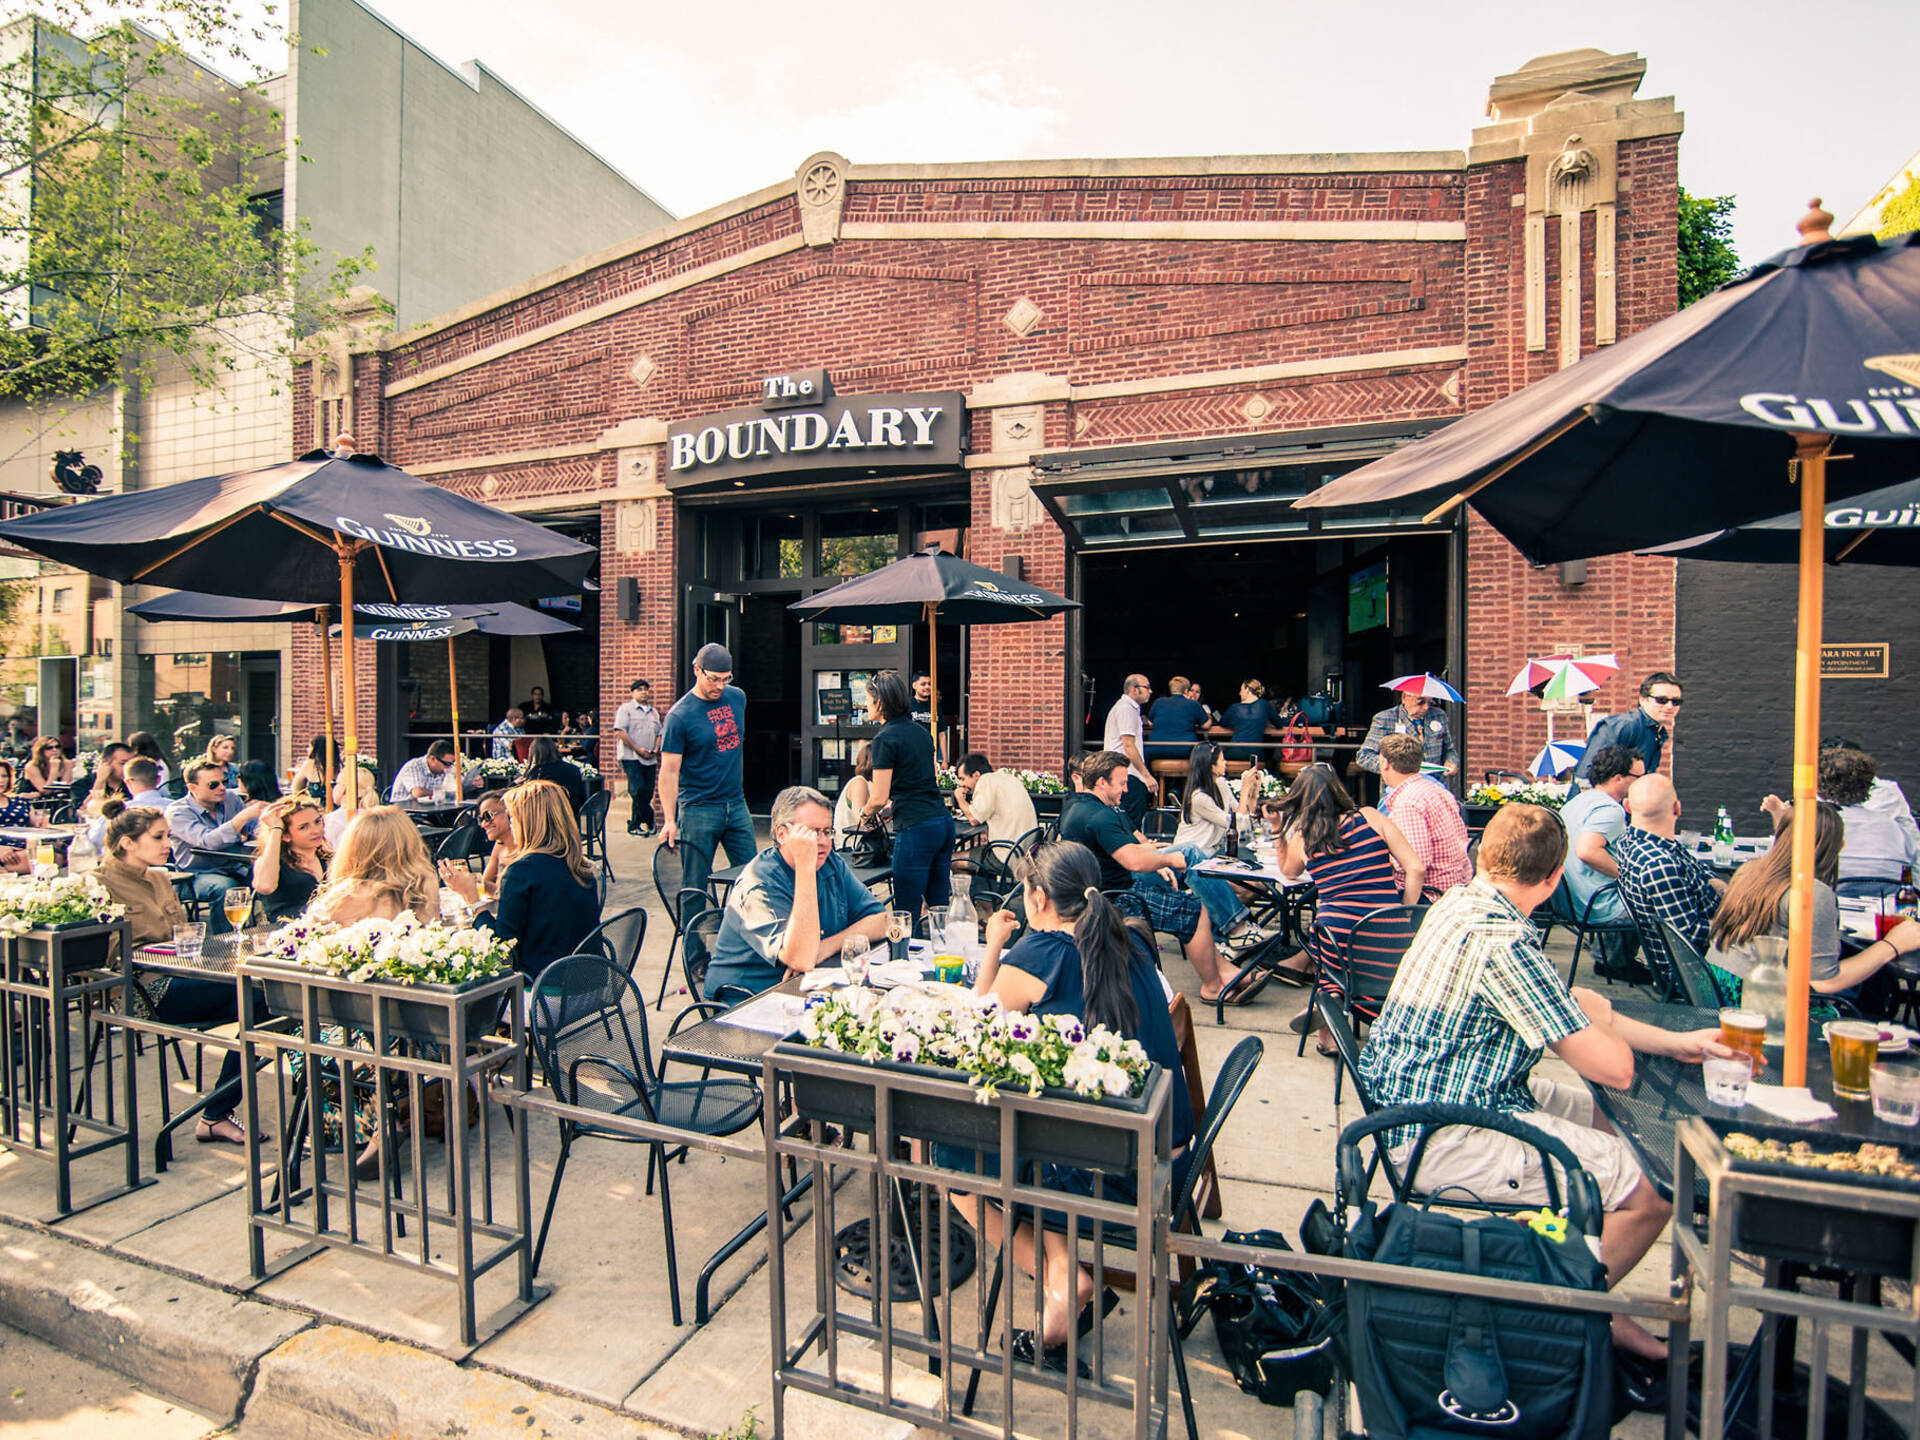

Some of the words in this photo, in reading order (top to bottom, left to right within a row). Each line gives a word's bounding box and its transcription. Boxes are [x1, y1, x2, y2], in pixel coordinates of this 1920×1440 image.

[763, 376, 814, 399] The
[670, 407, 943, 471] BOUNDARY
[1824, 508, 1920, 527] GUI
[335, 516, 517, 558] GUINNESS
[964, 590, 1044, 604] GUINNESS
[371, 625, 454, 640] GUINNESS
